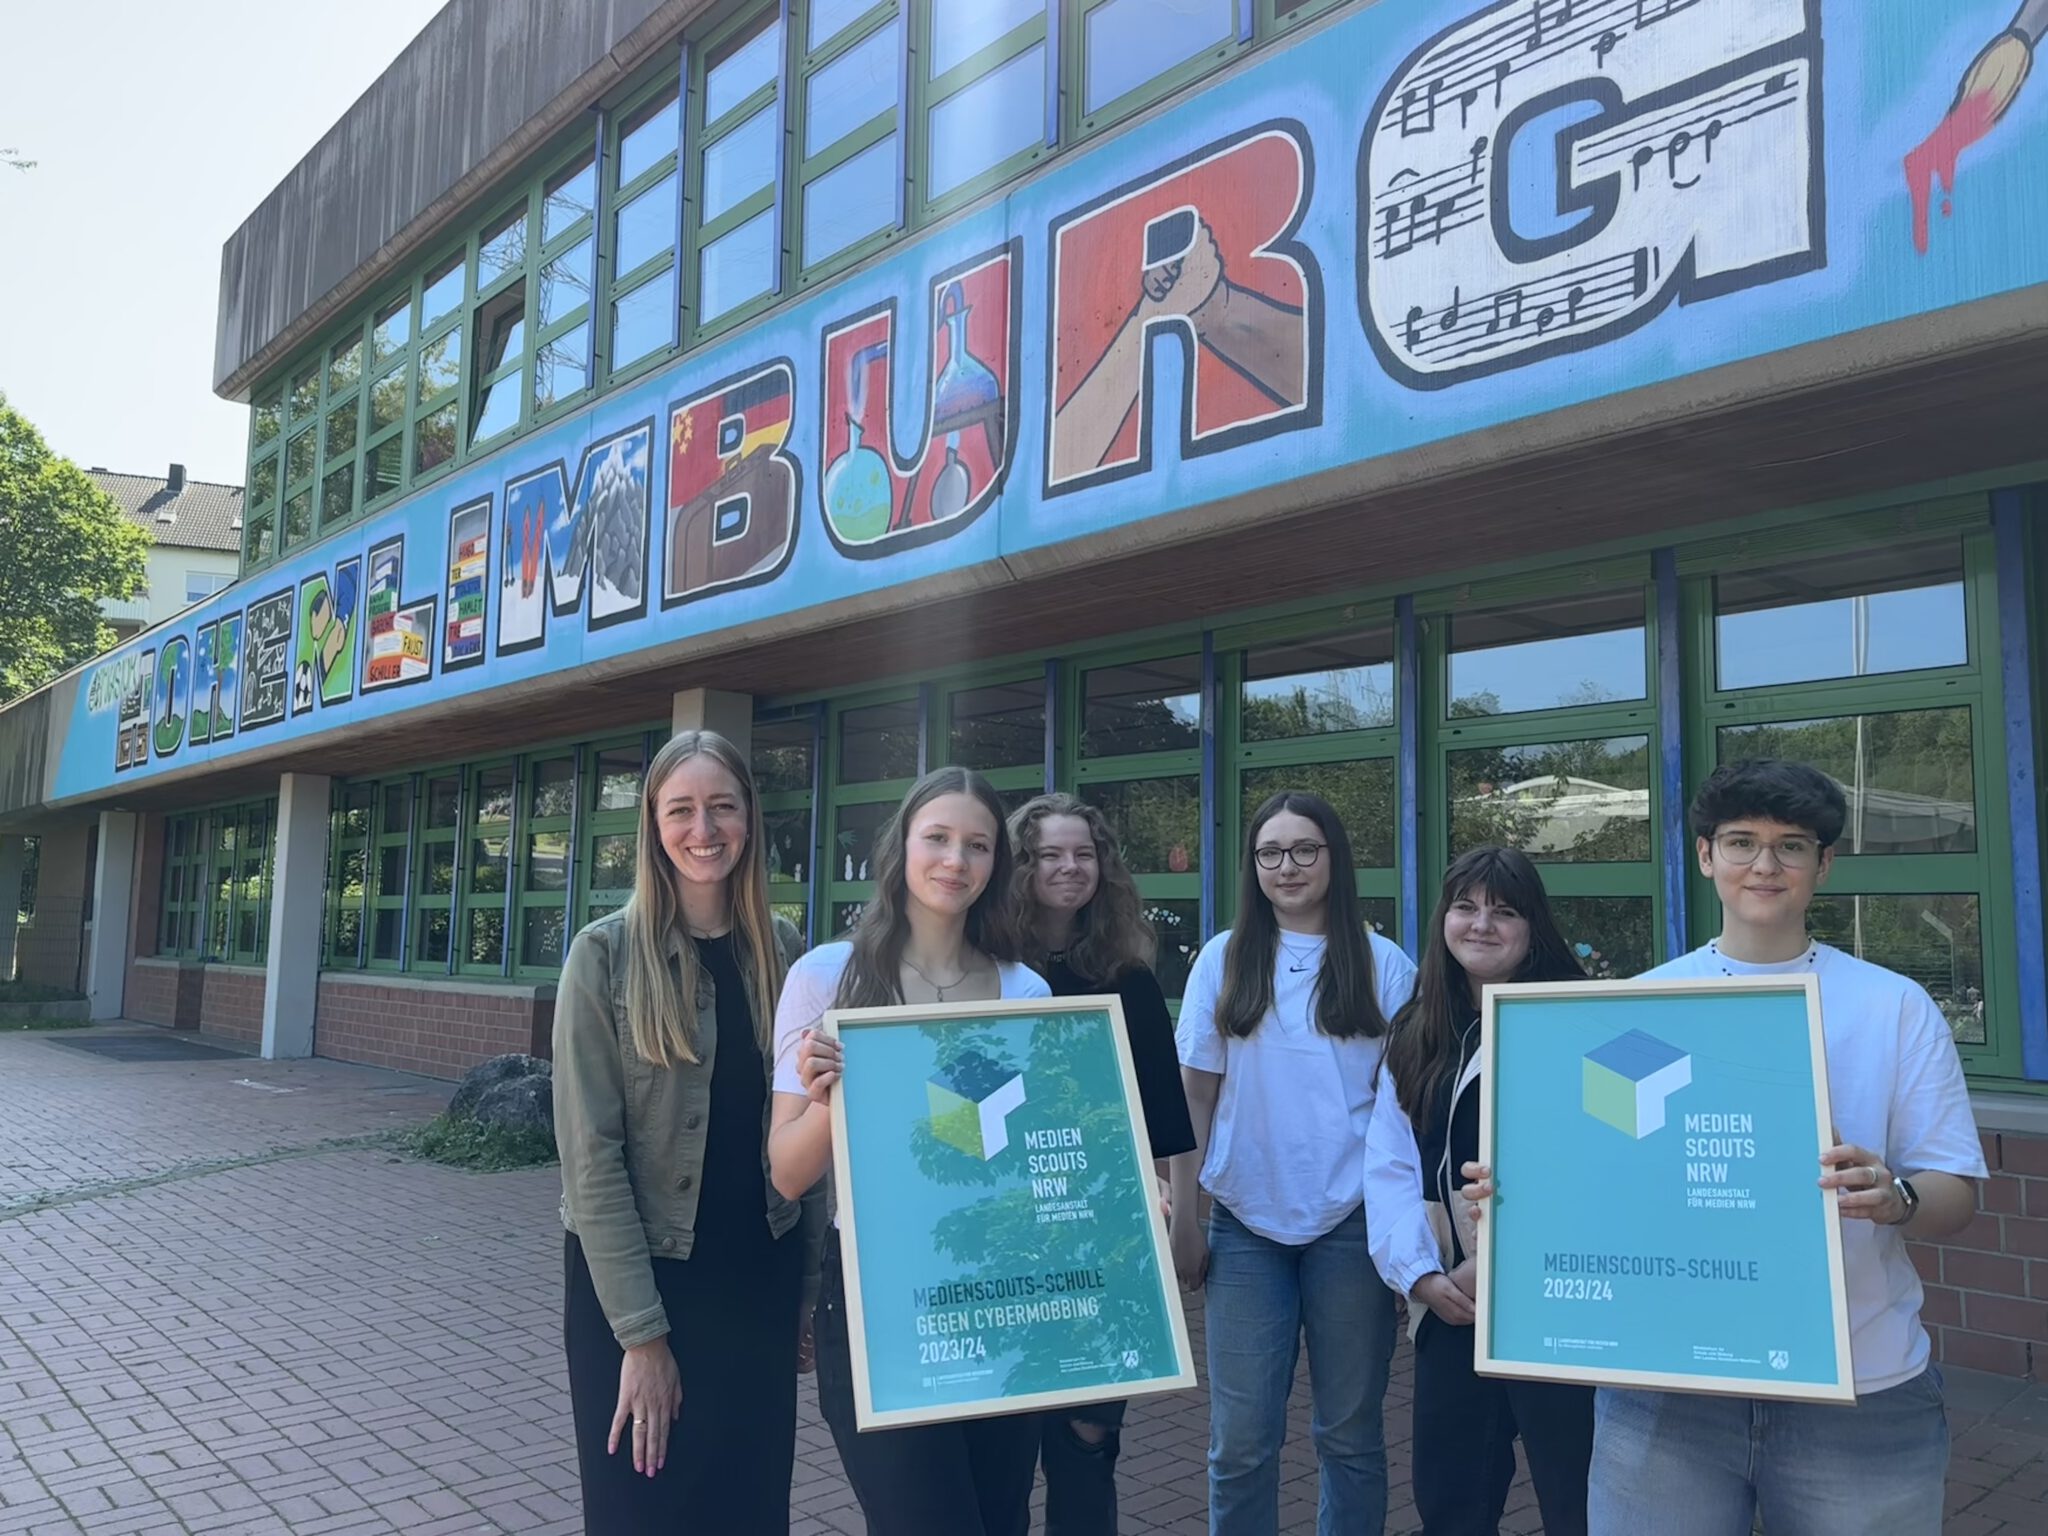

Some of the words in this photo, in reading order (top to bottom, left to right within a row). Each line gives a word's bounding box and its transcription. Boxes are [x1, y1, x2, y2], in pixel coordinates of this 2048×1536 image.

[403, 636, 424, 656] FAUST
[370, 664, 401, 682] SCHILLER
[1685, 1113, 1753, 1134] MEDIEN
[1024, 1128, 1082, 1151] MEDIEN
[1685, 1138, 1756, 1159] SCOUTS
[1028, 1151, 1088, 1174] SCOUTS
[1686, 1163, 1728, 1183] NRW
[1032, 1177, 1069, 1199] NRW
[1687, 1187, 1750, 1199] LANDESANSTALT
[1035, 1199, 1089, 1213] LANDESANSTALT
[1687, 1197, 1703, 1209] FÜR
[1705, 1198, 1735, 1209] MEDIEN
[1736, 1199, 1757, 1210] NRW
[1051, 1210, 1078, 1222] MEDIEN
[1079, 1209, 1095, 1221] NRW
[1543, 1252, 1759, 1282] MEDIENSCOUTS-SCHULE
[912, 1268, 1105, 1309] MEDIENSCOUTS-SCHULE
[1543, 1277, 1614, 1301] 2023/24
[916, 1309, 970, 1336] GEGEN
[974, 1295, 1100, 1332] CYBERMOBBING
[918, 1335, 987, 1365] 2023/24
